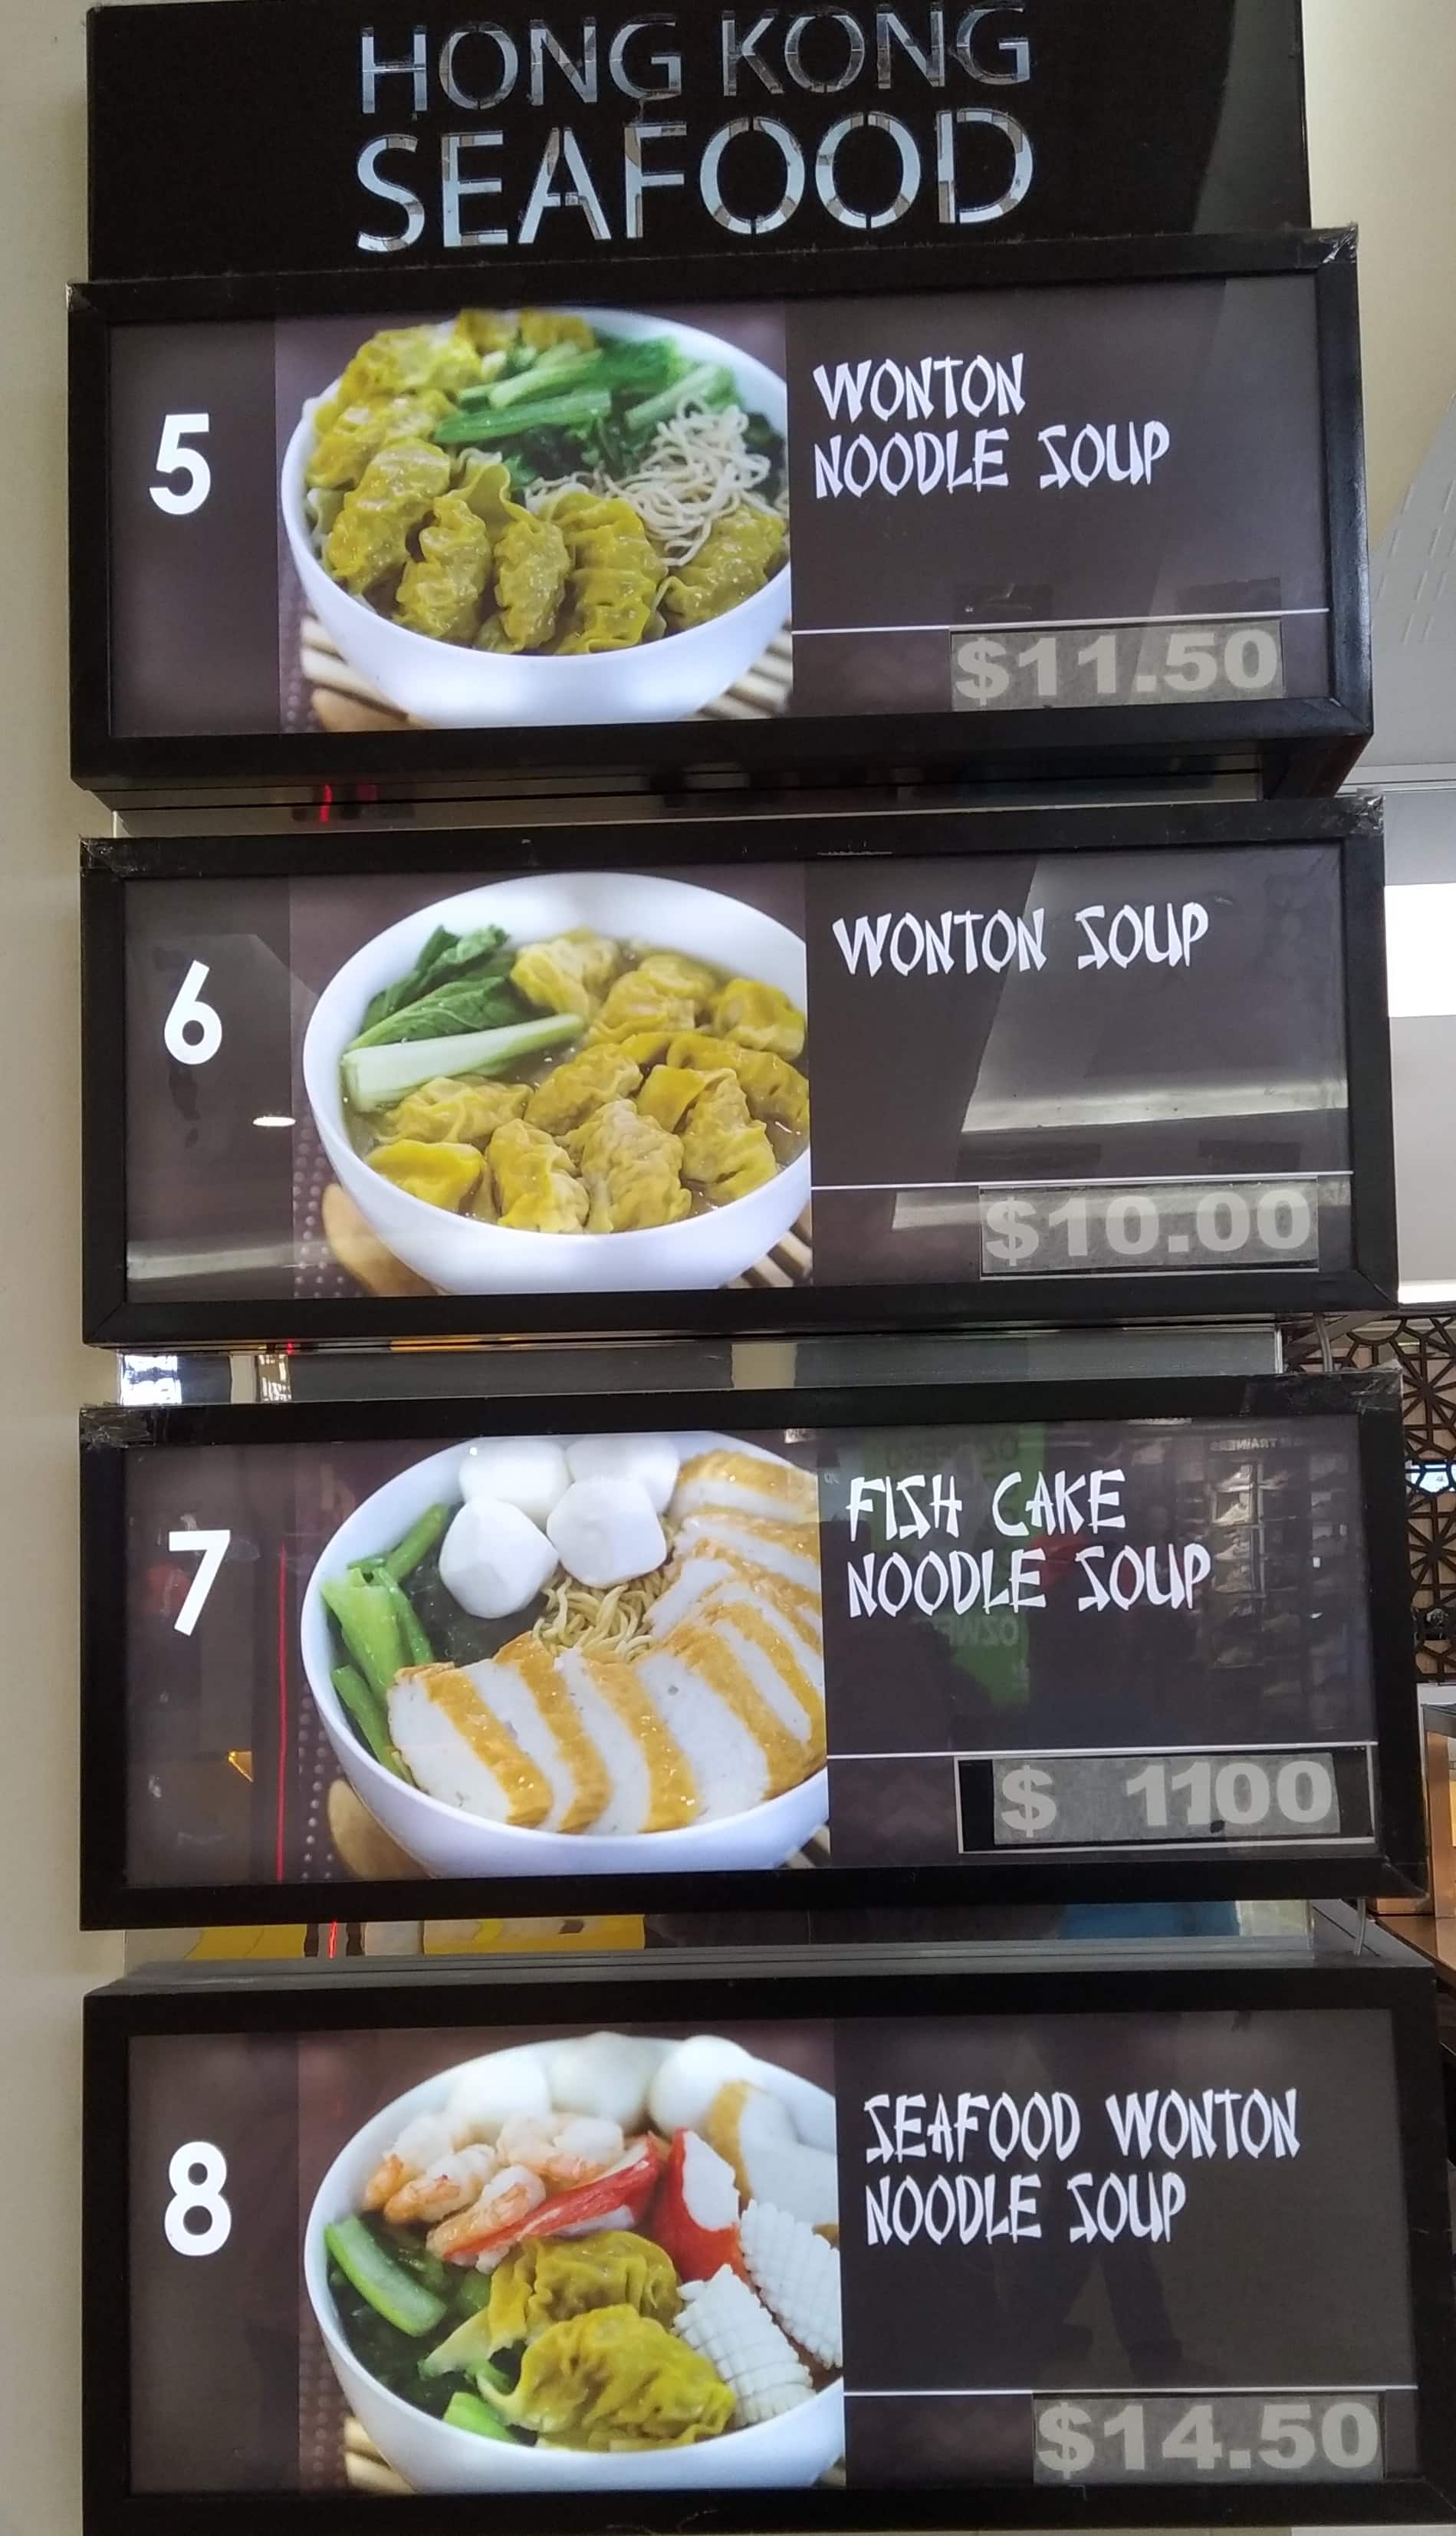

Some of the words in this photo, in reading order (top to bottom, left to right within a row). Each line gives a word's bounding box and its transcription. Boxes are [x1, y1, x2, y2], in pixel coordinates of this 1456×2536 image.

[362, 15, 682, 113] HONG
[721, 3, 1030, 95] KONG
[357, 108, 1033, 252] SEAFOOD
[813, 354, 1026, 423] WONTON
[149, 414, 211, 515] 5
[815, 428, 1009, 498] NOODLE
[1038, 421, 1170, 488] SOUP
[955, 630, 1278, 706] $11.50
[833, 907, 1046, 976] WONTON
[1075, 903, 1209, 969] SOUP
[163, 961, 222, 1064] 6
[985, 1190, 1310, 1266] $10.00
[846, 1475, 962, 1541] FISH
[993, 1469, 1126, 1537] CAKE
[169, 1529, 231, 1636] 7
[847, 1548, 1046, 1618] NOODLE
[1075, 1543, 1211, 1611] SOUP
[1001, 1765, 1057, 1838] $
[864, 2091, 1080, 2163] SEAFOOD
[1106, 2089, 1300, 2159] WONTON
[164, 2142, 232, 2256] 8
[866, 2175, 1041, 2245] NOODLE
[1067, 2172, 1185, 2245] SOUP
[1036, 2403, 1379, 2480] $14.50
